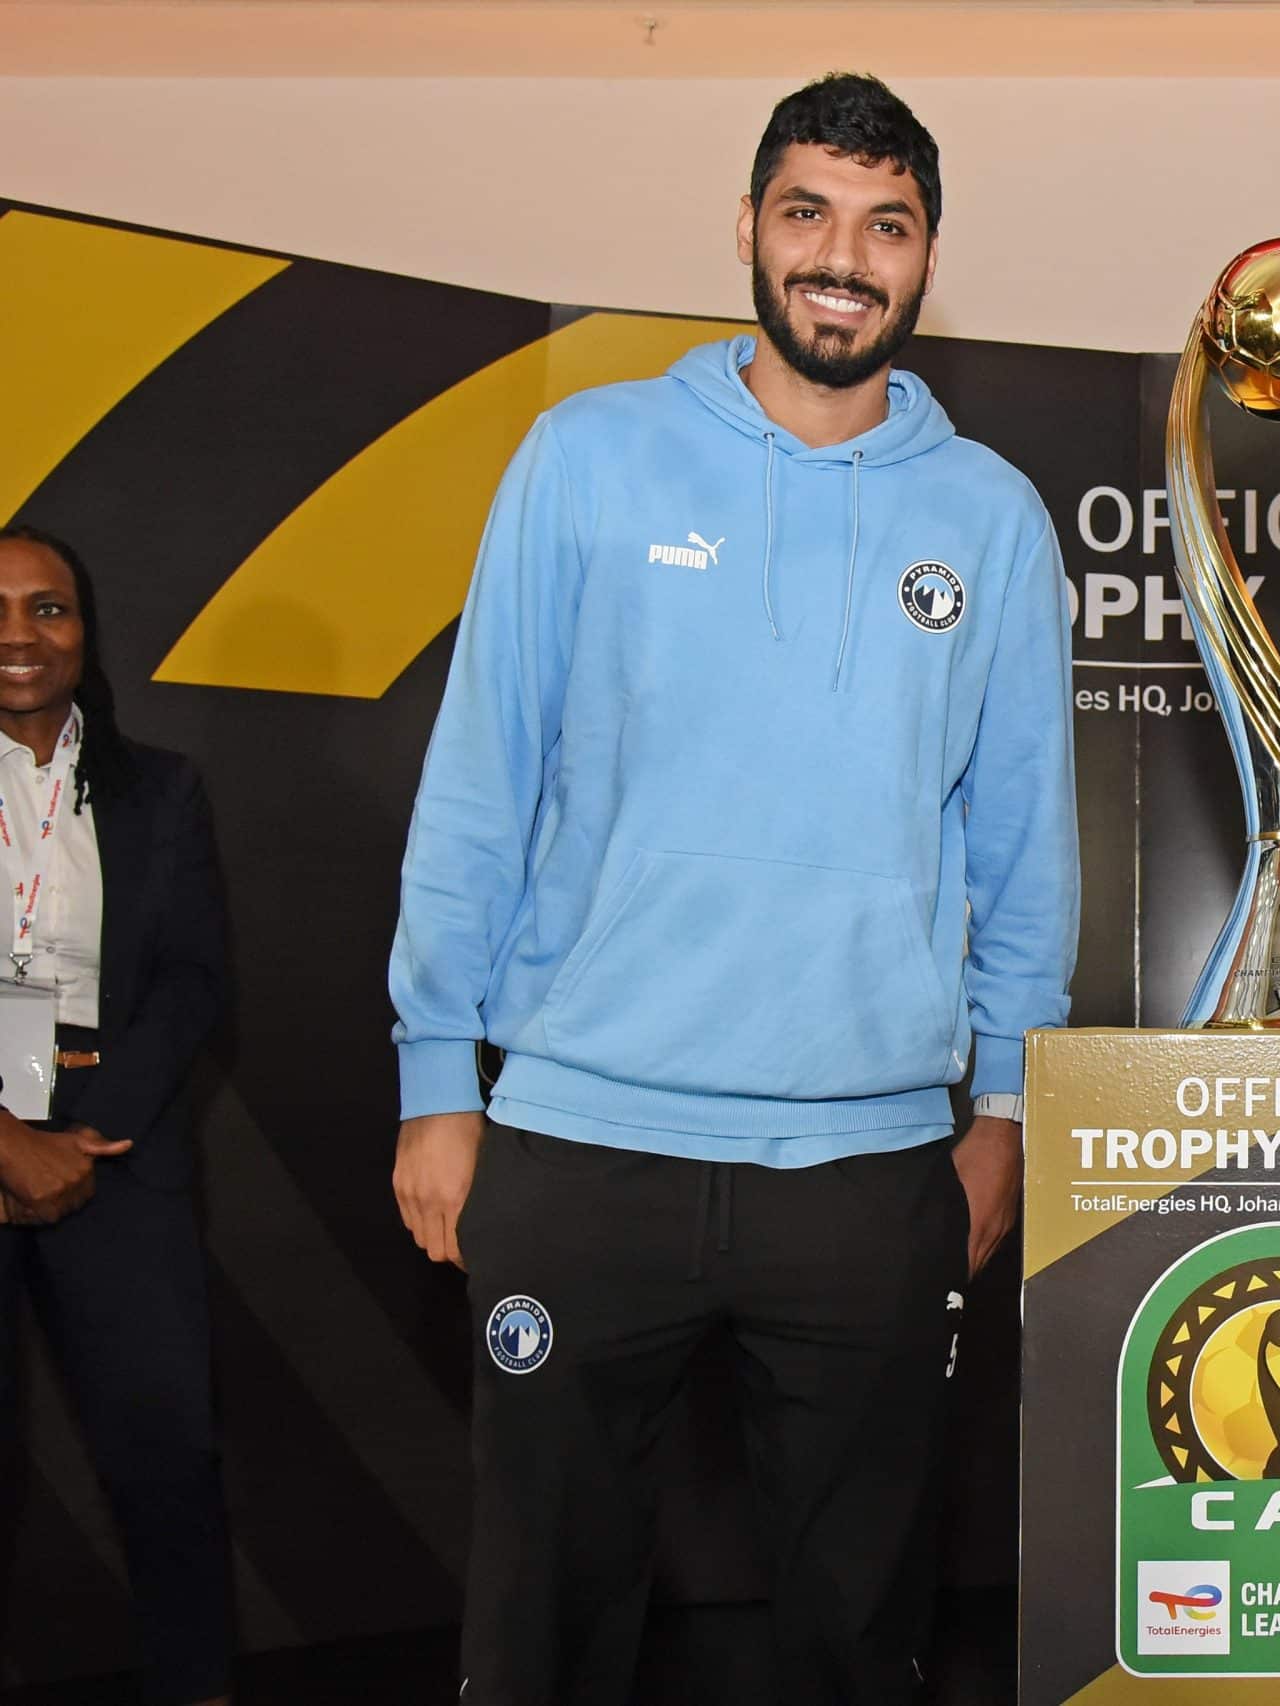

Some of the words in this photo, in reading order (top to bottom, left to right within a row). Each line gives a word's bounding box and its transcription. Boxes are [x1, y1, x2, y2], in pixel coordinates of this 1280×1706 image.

[648, 544, 708, 570] PUMA
[909, 565, 961, 593] PYRAMIDS
[1118, 685, 1171, 716] HQ,
[1071, 1194, 1196, 1214] TotalEnergies
[495, 1300, 545, 1324] PYRAMIDS
[1146, 1625, 1222, 1637] TotalEnergies
